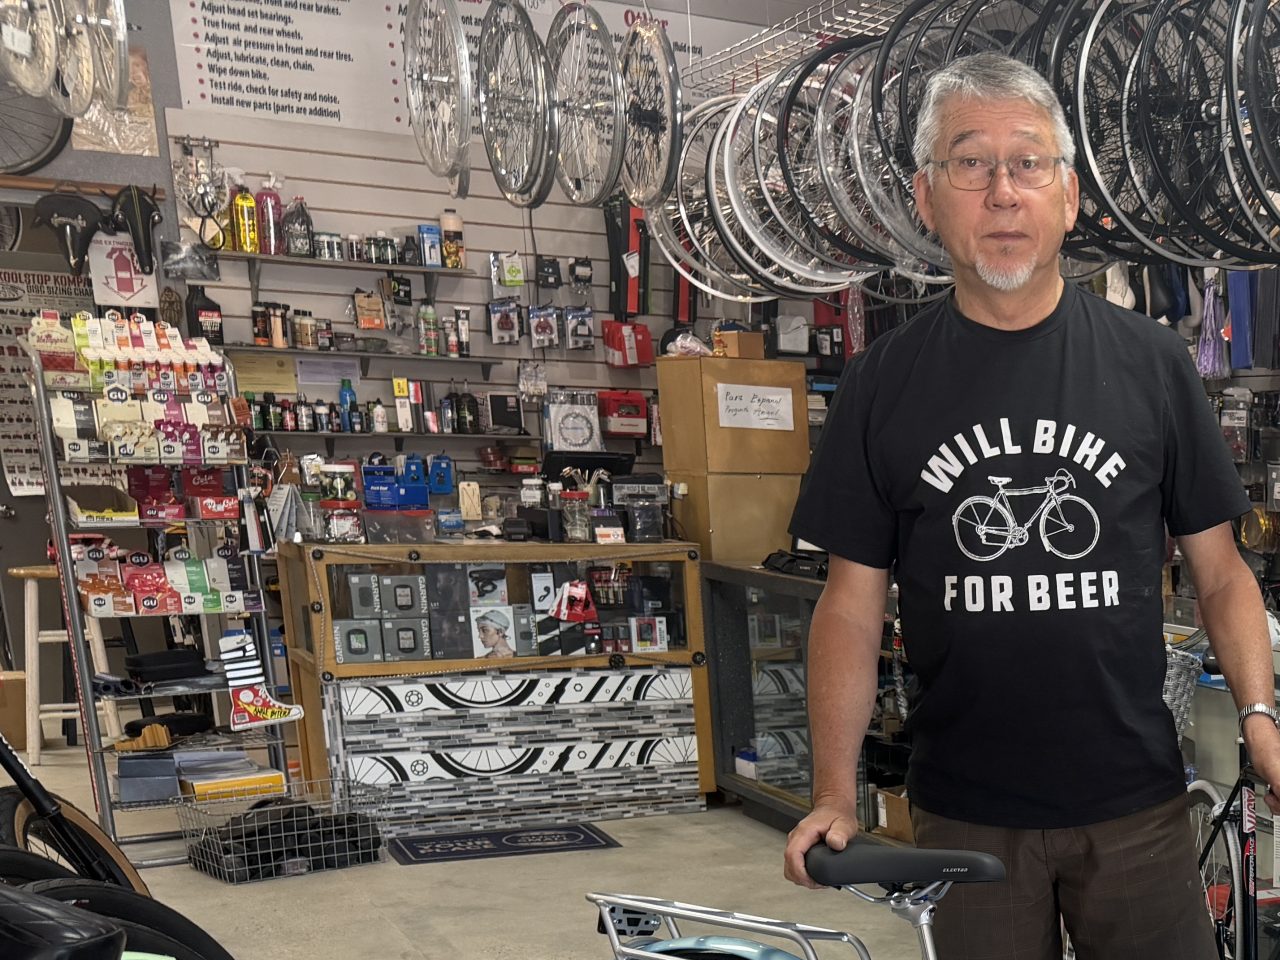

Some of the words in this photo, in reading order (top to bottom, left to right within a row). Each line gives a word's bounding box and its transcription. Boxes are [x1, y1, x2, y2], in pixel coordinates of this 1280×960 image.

[201, 3, 225, 16] Adjust
[226, 6, 246, 18] head
[247, 9, 258, 18] set
[259, 10, 294, 24] bearings.
[300, 3, 314, 12] rear
[315, 2, 341, 16] brakes.
[202, 17, 220, 30] True
[221, 19, 241, 32] front
[243, 23, 258, 34] and
[259, 26, 274, 36] rear
[275, 27, 303, 40] wheels.
[204, 32, 229, 46] Adjust
[232, 36, 243, 47] air
[243, 39, 275, 53] pressure
[276, 41, 284, 51] in
[284, 43, 304, 56] front
[304, 47, 319, 57] and
[319, 50, 334, 61] rear
[335, 51, 354, 62] tires.
[206, 48, 233, 63] Adjust,
[234, 52, 269, 67] lubricate,
[270, 57, 291, 70] clean,
[293, 60, 315, 72] chain.
[208, 63, 228, 77] Wipe
[229, 66, 250, 79] down
[251, 69, 269, 81] bike.
[210, 78, 226, 91] Test
[227, 81, 244, 94] ride,
[245, 83, 266, 97] check
[267, 86, 279, 98] for
[280, 88, 302, 103] safety
[303, 91, 317, 103] and
[318, 94, 340, 104] noise.
[210, 94, 235, 106] Install
[235, 99, 252, 108] new
[253, 100, 272, 112] parts
[272, 101, 295, 115] (parts
[295, 105, 307, 115] are
[308, 106, 341, 122] addition)
[53, 274, 93, 289] KOMPA
[26, 284, 46, 294] DISC
[47, 285, 72, 296] SIZING
[73, 287, 94, 297] CHAR
[109, 390, 127, 401] GU
[154, 393, 169, 402] GU
[198, 394, 212, 403] GU
[920, 417, 1022, 494] WILL
[1032, 418, 1127, 488] BIKE
[89, 551, 104, 561] GU
[133, 555, 149, 565] GU
[176, 552, 190, 561] GU
[218, 549, 232, 558] GU
[370, 575, 381, 612] GARMIN
[418, 576, 428, 614] GARMIN
[944, 575, 1014, 612] FOR
[1027, 570, 1120, 611] BEER
[94, 598, 106, 607] GU
[143, 598, 159, 608] GU
[184, 597, 196, 605] GU
[225, 596, 236, 604] GU
[421, 619, 431, 656] GARMIN
[530, 615, 539, 650] GARMIN
[333, 626, 344, 664] GARMIN
